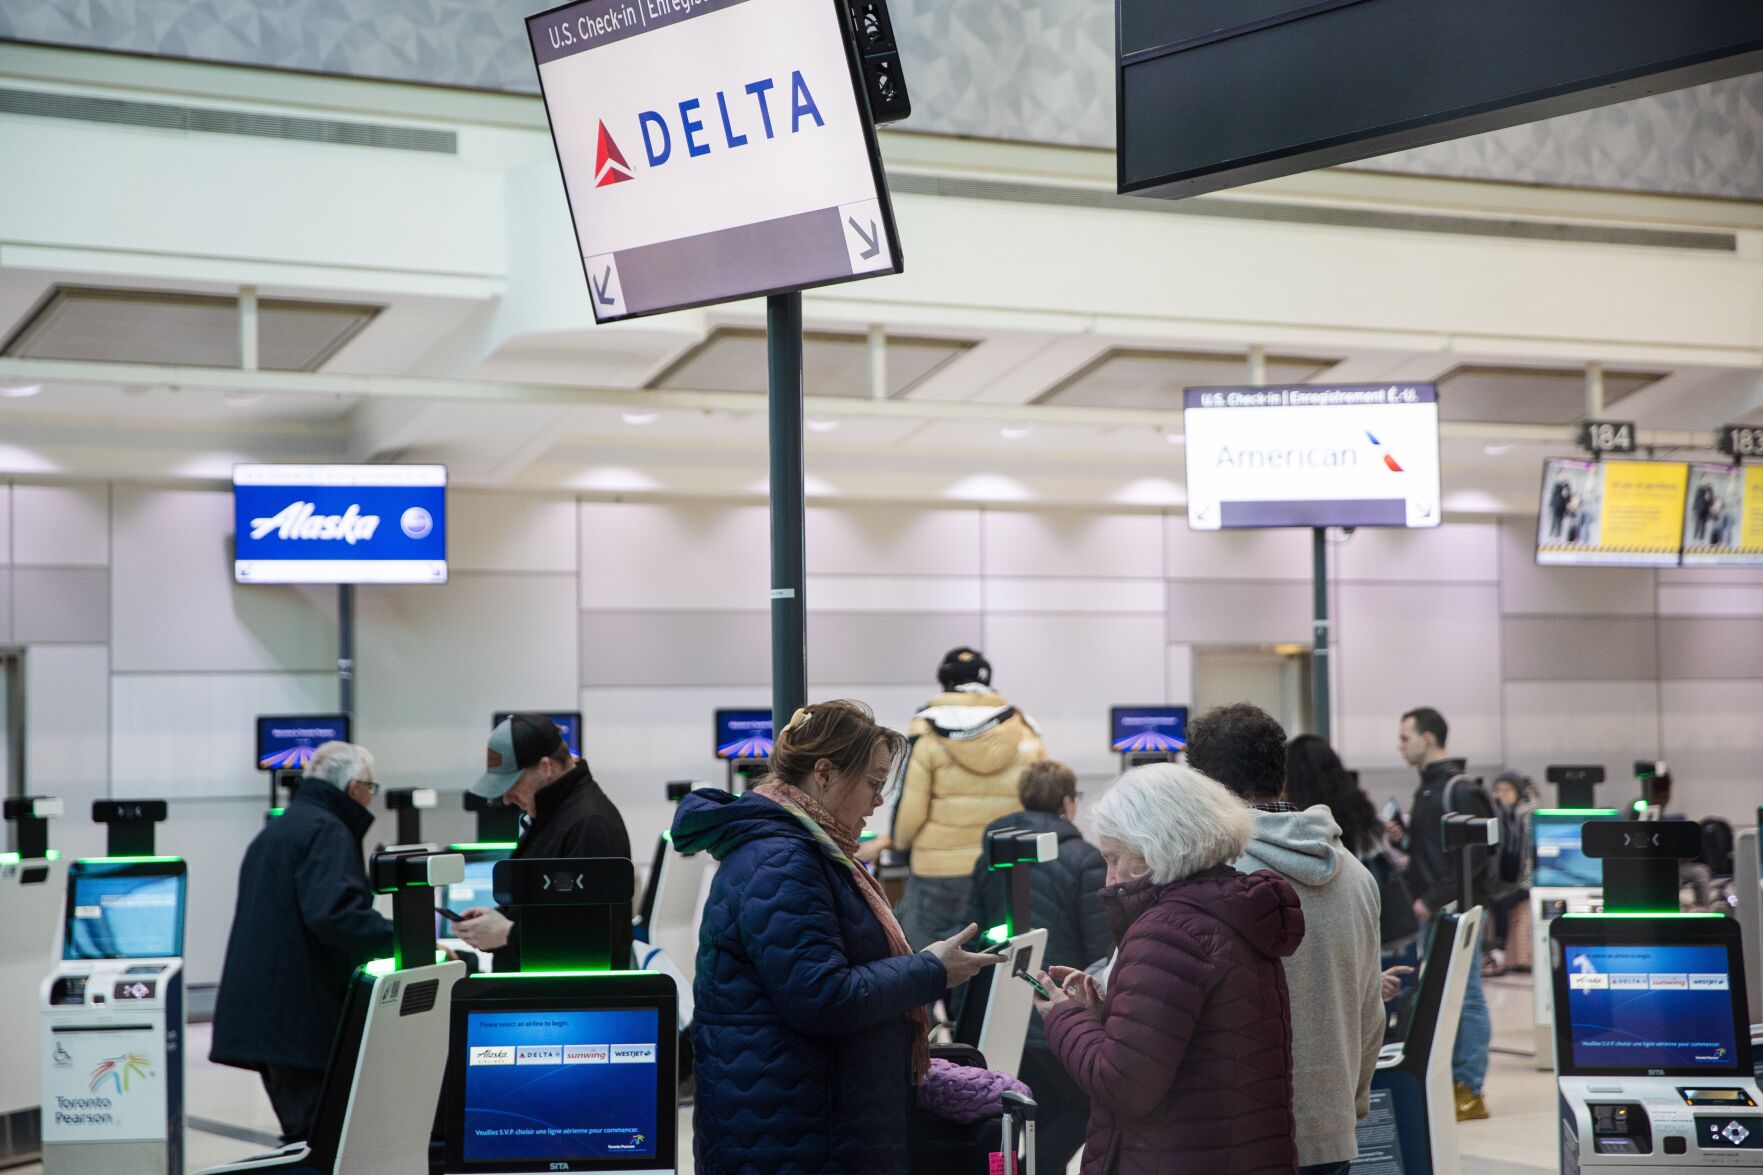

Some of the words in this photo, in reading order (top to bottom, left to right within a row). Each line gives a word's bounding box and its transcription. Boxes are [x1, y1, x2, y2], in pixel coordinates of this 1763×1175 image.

[548, 22, 577, 49] U.S.
[577, 4, 637, 40] Check-in
[637, 70, 825, 168] DELTA
[1200, 392, 1227, 408] U.S.
[1227, 391, 1282, 407] Check-in
[1289, 389, 1386, 406] Enregistrement
[1588, 423, 1631, 450] 184
[1731, 428, 1763, 455] 183
[1215, 446, 1357, 468] American
[250, 500, 380, 545] Alaska
[476, 1049, 508, 1059] Alaska
[567, 1051, 606, 1060] sunwing
[614, 1050, 644, 1058] WESTJET
[55, 1096, 112, 1109] Toronto
[55, 1112, 112, 1125] Pearson
[547, 1128, 562, 1136] ligne
[549, 1162, 569, 1170] SITA
